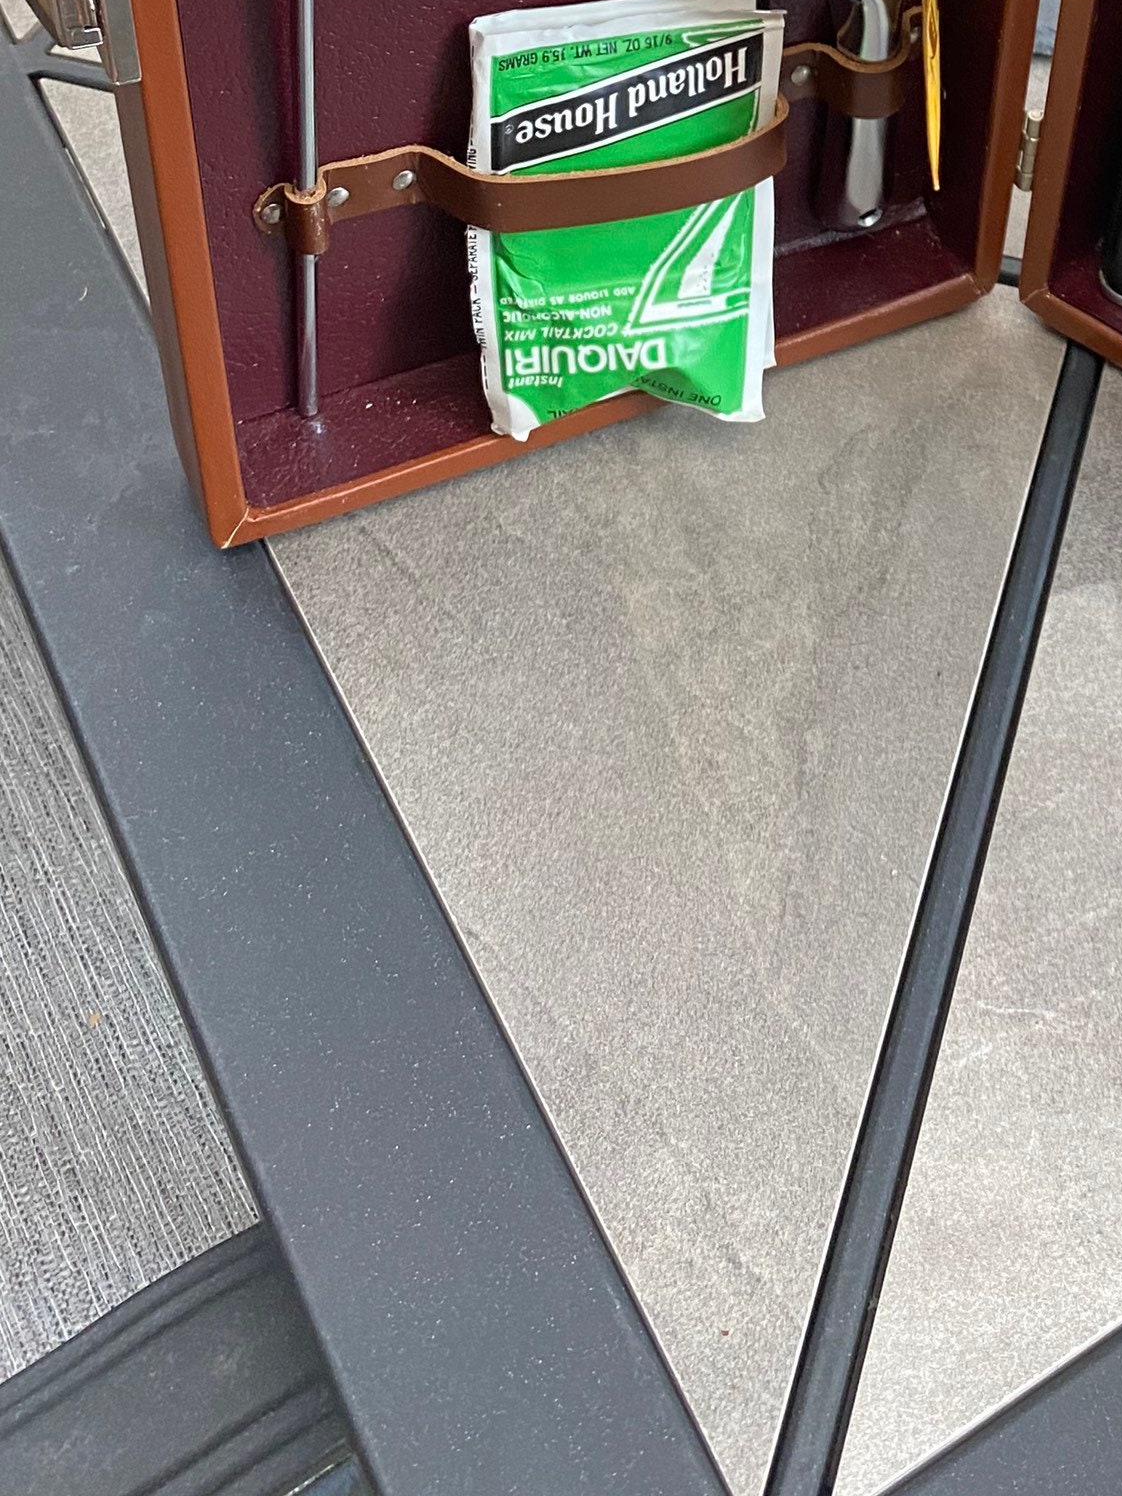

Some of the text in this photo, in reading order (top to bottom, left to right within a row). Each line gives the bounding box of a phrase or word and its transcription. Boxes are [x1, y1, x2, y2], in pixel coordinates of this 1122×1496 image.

[570, 44, 592, 59] WT.
[596, 40, 617, 55] NET
[498, 52, 538, 71] GRAMS
[515, 47, 748, 144] Holland House
[500, 286, 636, 309] ADD LIQUOR AS DIREED
[504, 322, 619, 342] COCKTAIL MIX
[505, 337, 668, 376] DAIQUIRI
[508, 376, 564, 389] Instant
[688, 393, 722, 406] ONE
